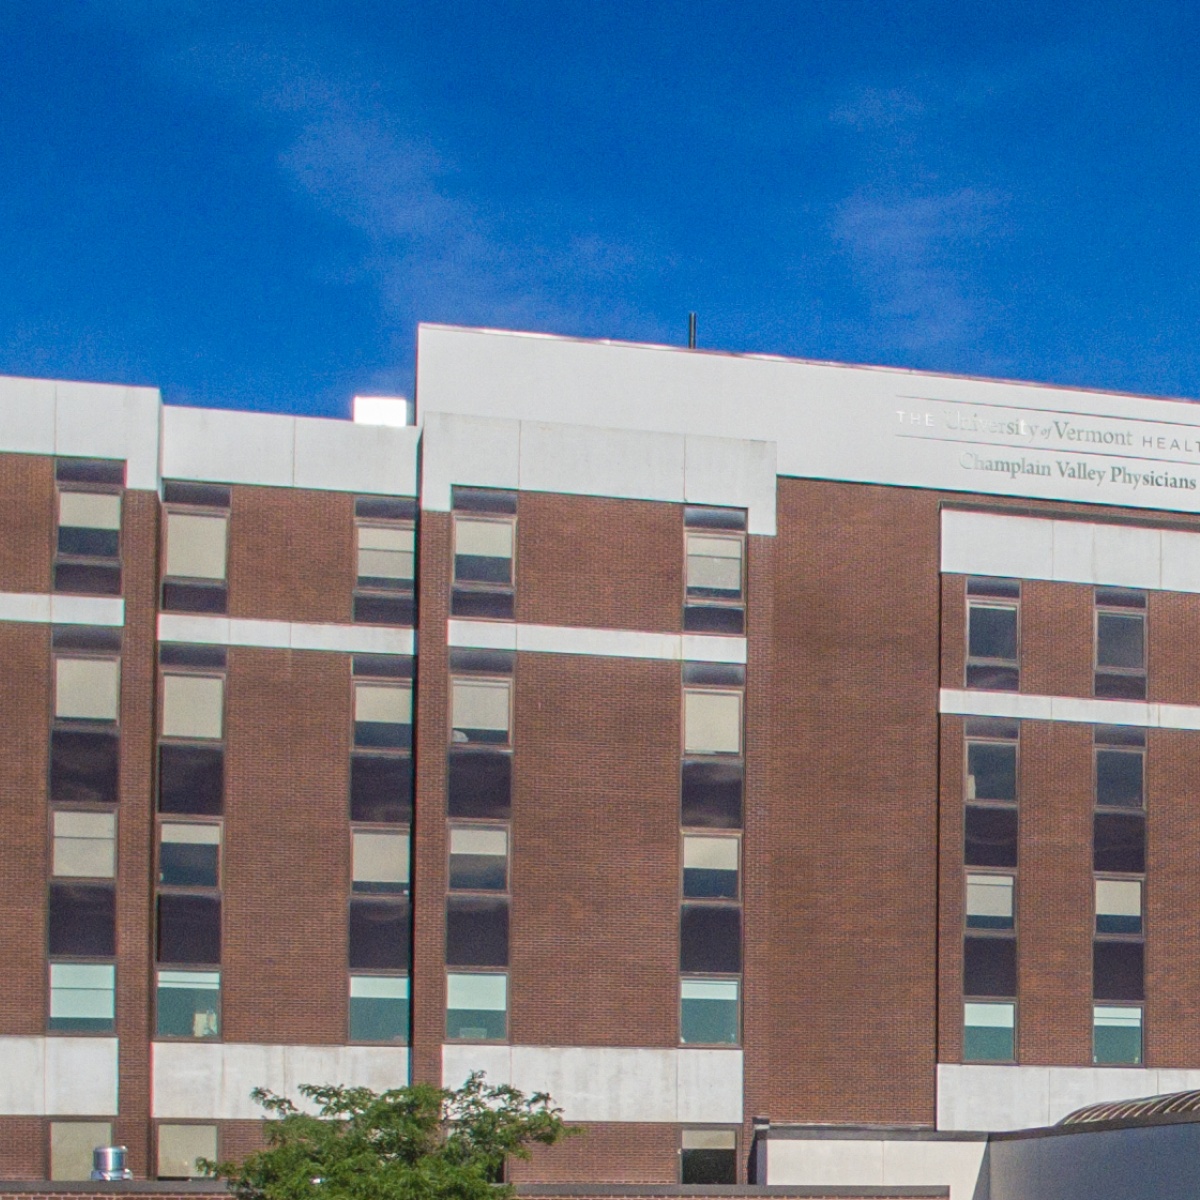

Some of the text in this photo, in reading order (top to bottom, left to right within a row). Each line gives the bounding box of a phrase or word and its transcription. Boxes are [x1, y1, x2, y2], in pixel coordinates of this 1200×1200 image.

[896, 410, 935, 427] THE
[1040, 425, 1053, 440] of
[1053, 420, 1134, 446] Vermont
[959, 452, 1052, 479] Champlain
[1055, 460, 1107, 487] Valley
[1110, 466, 1197, 490] Physicians
